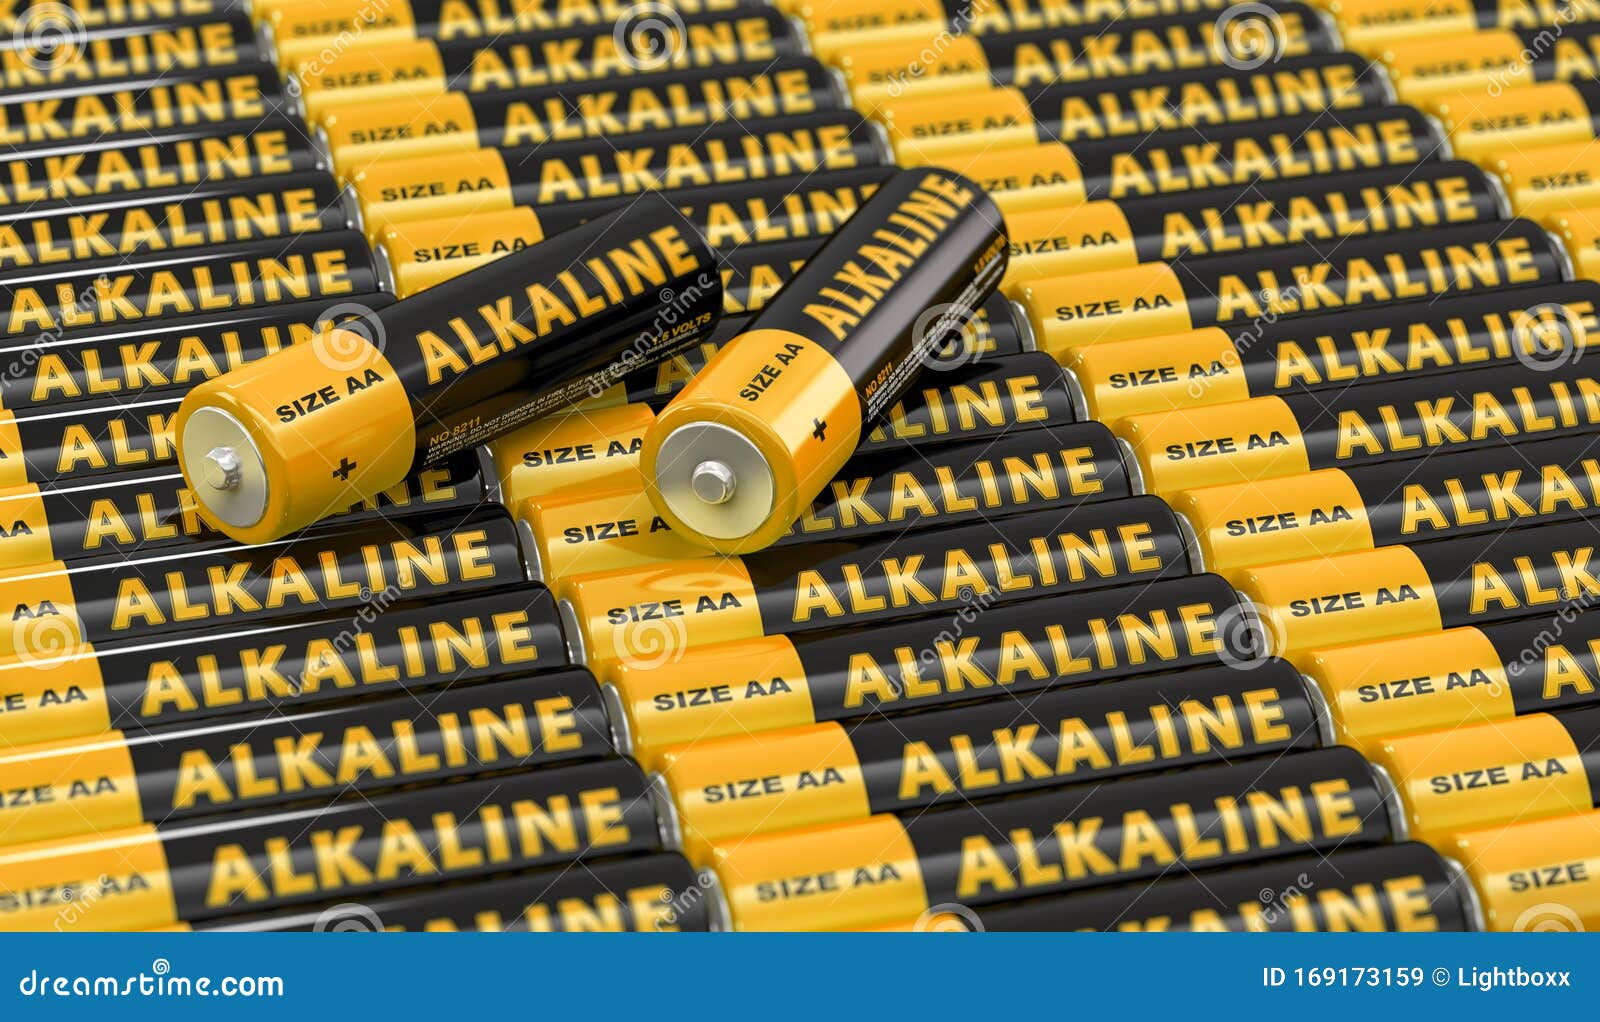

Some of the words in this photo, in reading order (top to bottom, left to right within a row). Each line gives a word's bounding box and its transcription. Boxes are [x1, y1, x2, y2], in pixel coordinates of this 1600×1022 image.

[0, 22, 238, 88] KALINE
[503, 70, 817, 147] ALKALINE
[1060, 64, 1363, 141] ALKALINE
[350, 125, 412, 144] SIZE
[424, 120, 462, 134] AA
[538, 125, 858, 204] ALKALINE
[1110, 118, 1419, 198] ALKALINE
[382, 182, 446, 201] SIZE
[456, 176, 495, 192] AA
[1029, 171, 1068, 188] AA
[0, 188, 322, 267] ALKALINE
[1161, 176, 1478, 259] ALKALINE
[413, 242, 481, 264] SIZE
[492, 237, 529, 252] AA
[802, 173, 975, 341] ALKALINE
[1079, 231, 1119, 247] AA
[7, 249, 353, 334] ALKALINE
[1216, 237, 1541, 323] ALKALINE
[416, 225, 699, 385] ALKALINE
[1055, 300, 1123, 321] SIZE
[1133, 294, 1173, 311] AA
[672, 312, 712, 337] VOLTS
[31, 314, 362, 401] ALKALI
[740, 364, 782, 402] SIZE
[778, 343, 804, 366] AA
[1109, 367, 1178, 389] SIZE
[1188, 360, 1230, 379] AA
[276, 385, 341, 424] SIZE
[345, 368, 384, 396] AA
[865, 380, 877, 398] NO
[877, 361, 893, 385] 8211
[453, 415, 481, 435] 8211
[866, 375, 1049, 443] LINE
[522, 443, 596, 468] SIZE
[1165, 438, 1238, 461] SIZE
[1247, 430, 1290, 451] AA
[564, 520, 639, 545] SIZE
[1225, 512, 1300, 537] SIZE
[1309, 505, 1354, 526] AA
[112, 529, 496, 631] ALKALINE
[793, 522, 1162, 623] ALKALINE
[12, 600, 60, 621] AA
[607, 600, 685, 625] SIZE
[695, 592, 743, 613] AA
[1290, 591, 1366, 617] SIZE
[1375, 584, 1421, 605] AA
[141, 610, 538, 717] ALKALINE
[844, 602, 1225, 708] ALKALINE
[39, 685, 88, 708] AA
[654, 685, 734, 711] SIZE
[744, 676, 792, 698] AA
[1357, 677, 1435, 704] SIZE
[1445, 668, 1493, 691] AA
[172, 695, 584, 810] ALKALINE
[899, 687, 1292, 800] ALKALINE
[68, 776, 118, 799] AA
[703, 775, 784, 803] SIZE
[796, 767, 845, 790] AA
[1431, 766, 1511, 795] SIZE
[1520, 758, 1568, 781] AA
[206, 786, 632, 908] ALKALINE
[956, 778, 1363, 898] ALKALINE
[755, 872, 840, 903] SIZE
[851, 863, 903, 887] AA
[1508, 862, 1590, 893] SIZE
